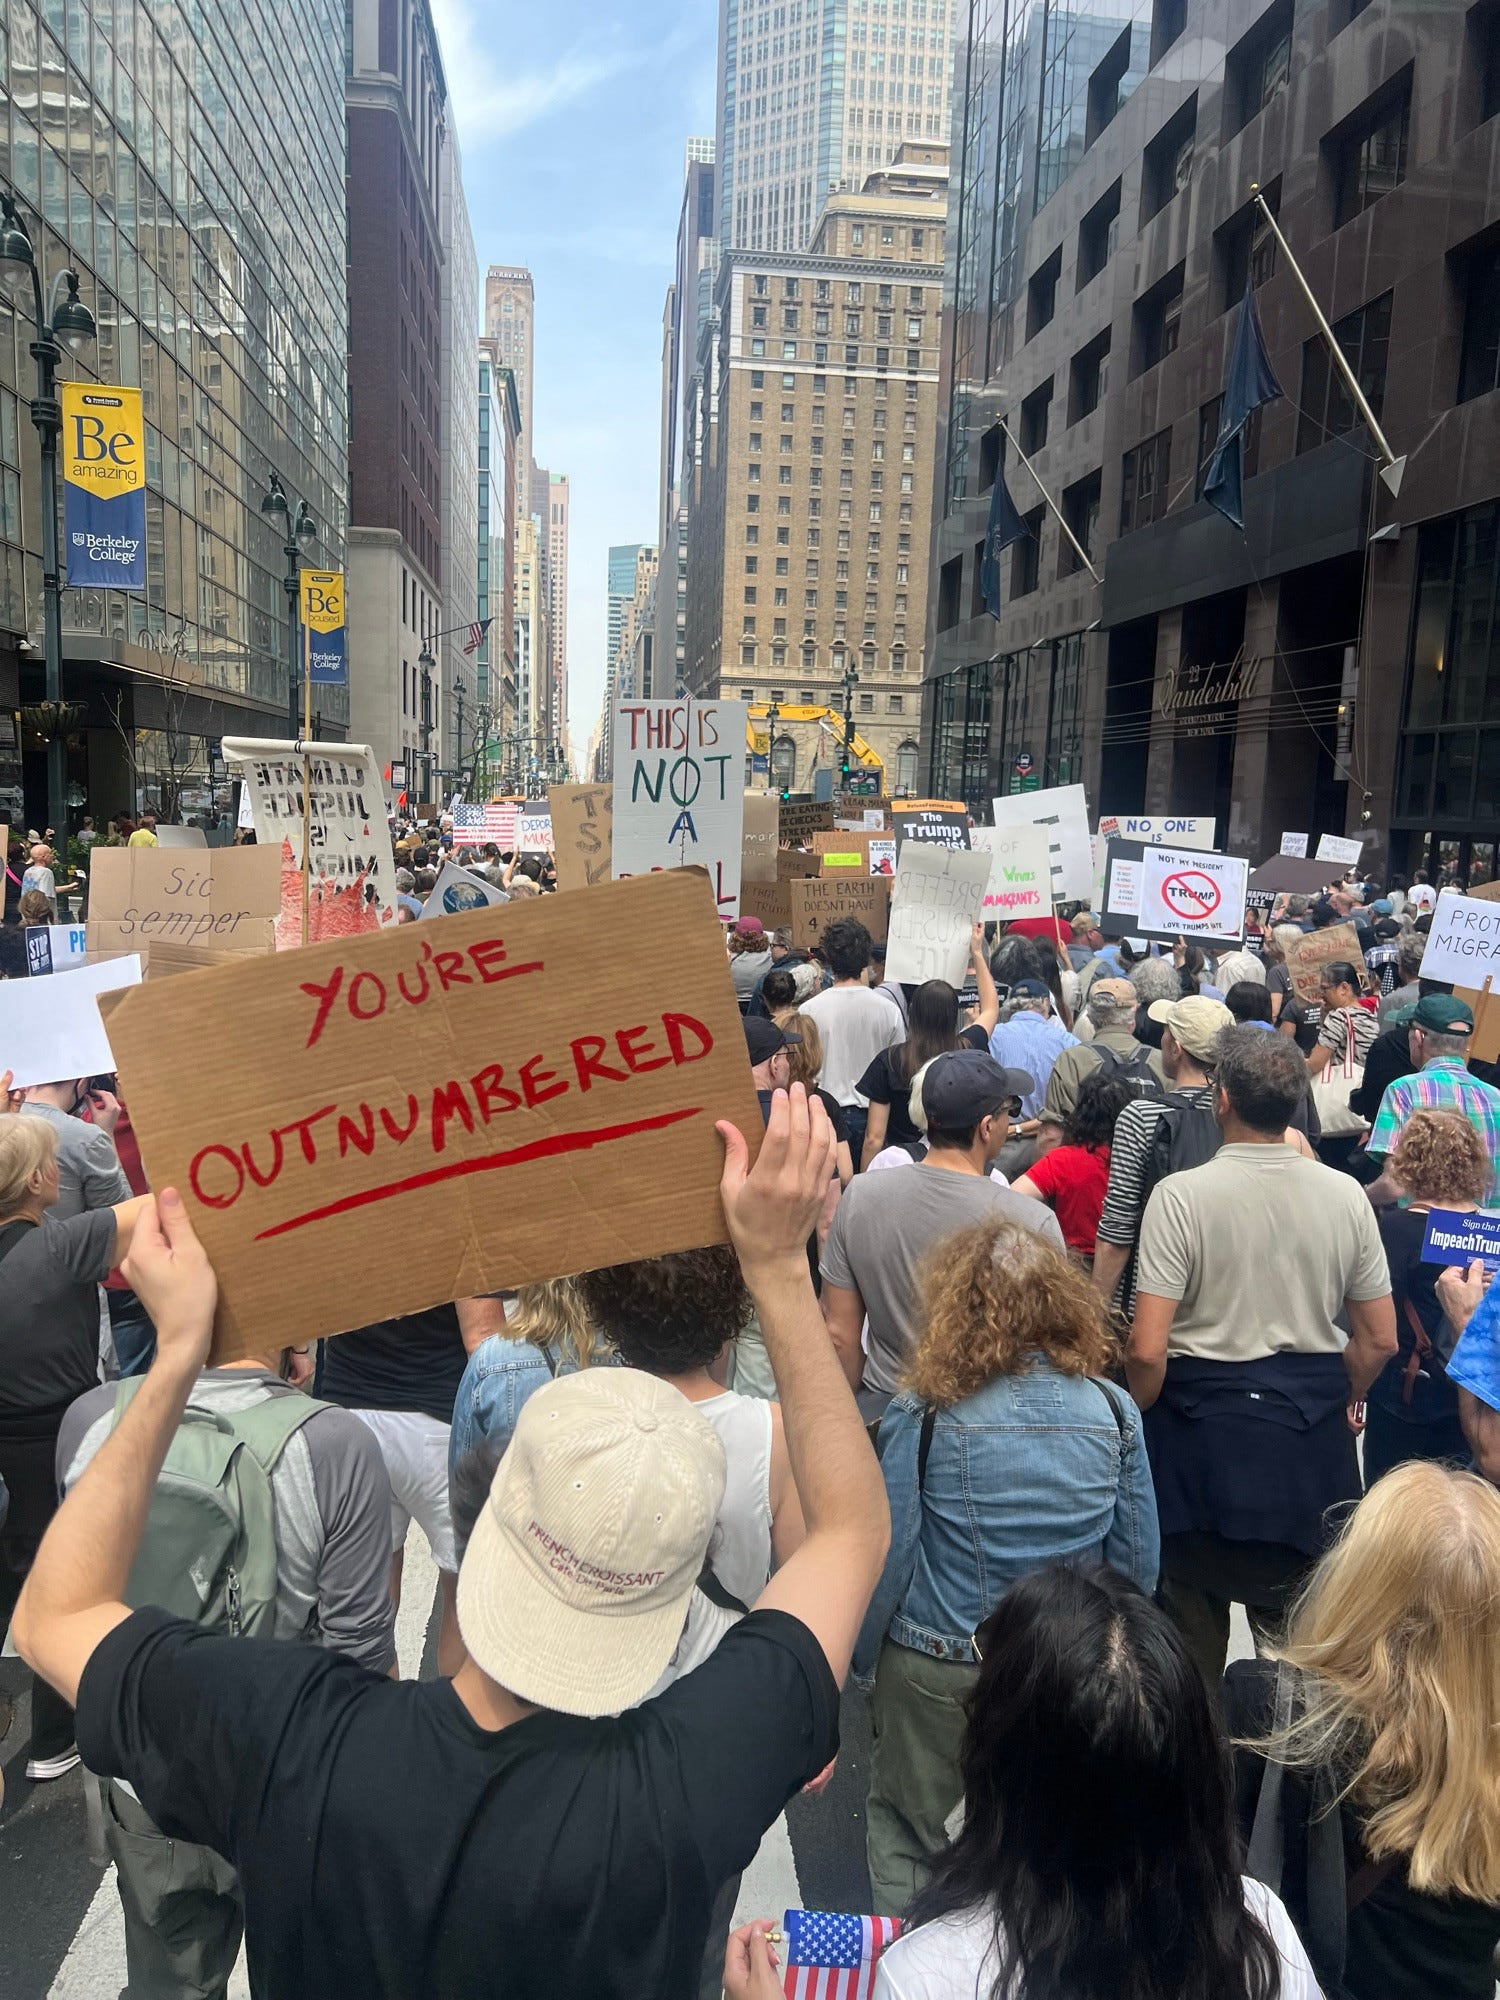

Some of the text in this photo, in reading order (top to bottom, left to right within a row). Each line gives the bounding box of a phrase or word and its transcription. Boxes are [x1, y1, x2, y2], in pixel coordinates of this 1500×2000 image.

[70, 415, 136, 465] Be
[73, 464, 137, 485] amazing
[86, 533, 140, 551] Berkeley
[89, 548, 136, 566] College
[305, 587, 340, 614] Be
[309, 615, 340, 623] ocused
[312, 652, 342, 662] Berkeley
[314, 659, 340, 671] College
[1158, 642, 1262, 720] Vanderbilt
[1188, 665, 1200, 683] 22
[620, 706, 719, 751] THIS IS
[632, 755, 733, 807] NOT
[920, 812, 943, 822] The
[521, 819, 553, 833] DEPOR
[668, 811, 698, 844] A
[903, 823, 963, 841] Trump
[1126, 820, 1197, 832] NO ONE
[523, 834, 554, 847] MUS
[1152, 833, 1163, 843] IS
[1000, 841, 1021, 853] OF
[1158, 854, 1224, 871] NOT MY PRESIDENT
[164, 867, 215, 898] Sic
[803, 882, 875, 898] THE EARTH
[982, 890, 1041, 910] MMIGRANTS
[1168, 887, 1215, 901] TRUMP
[1247, 890, 1274, 901] NAPPED
[803, 899, 875, 913] DOESNT HAVE
[119, 908, 251, 946] semper
[808, 917, 819, 930] 4
[1163, 921, 1180, 930] LOVE
[1182, 922, 1209, 931] TRUMPS
[1295, 974, 1318, 989] DUE
[299, 939, 545, 1049] YOU'RE
[189, 1012, 715, 1211] OUTNUMBERED
[1462, 1218, 1497, 1233] Sign the
[528, 1520, 665, 1588] FRENCH CROISSANT
